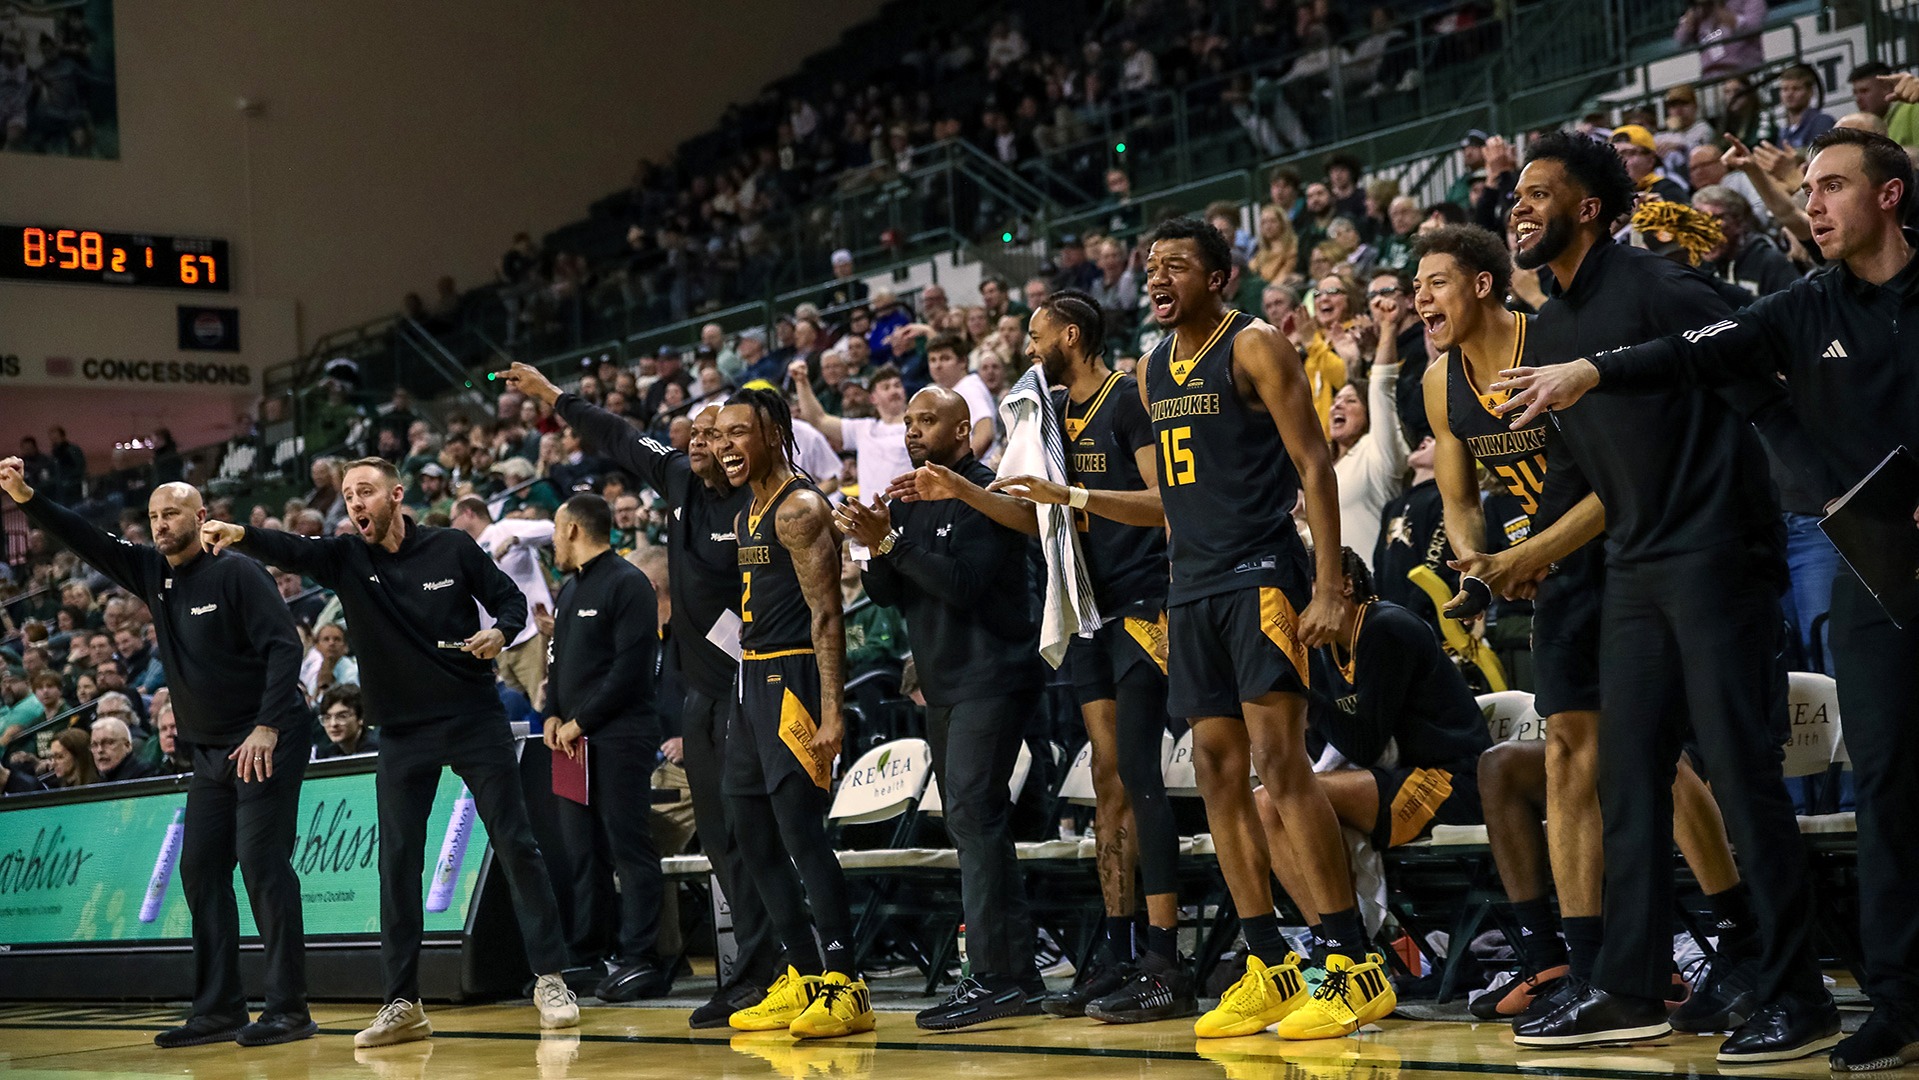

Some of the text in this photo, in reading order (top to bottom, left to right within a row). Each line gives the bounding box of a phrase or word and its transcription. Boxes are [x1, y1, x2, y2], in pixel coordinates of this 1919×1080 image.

[23, 227, 103, 271] 8:58
[111, 248, 127, 272] 2
[180, 254, 216, 284] 67
[83, 357, 250, 385] CONCESSIONS
[1151, 394, 1219, 423] MILWAUKEE
[1161, 426, 1196, 487] 15
[1467, 426, 1546, 458] MILWAUKE
[741, 571, 754, 623] 2
[1786, 731, 1819, 747] alth
[873, 779, 904, 798] health
[291, 798, 379, 876] bliss
[0, 825, 93, 894] arbliss
